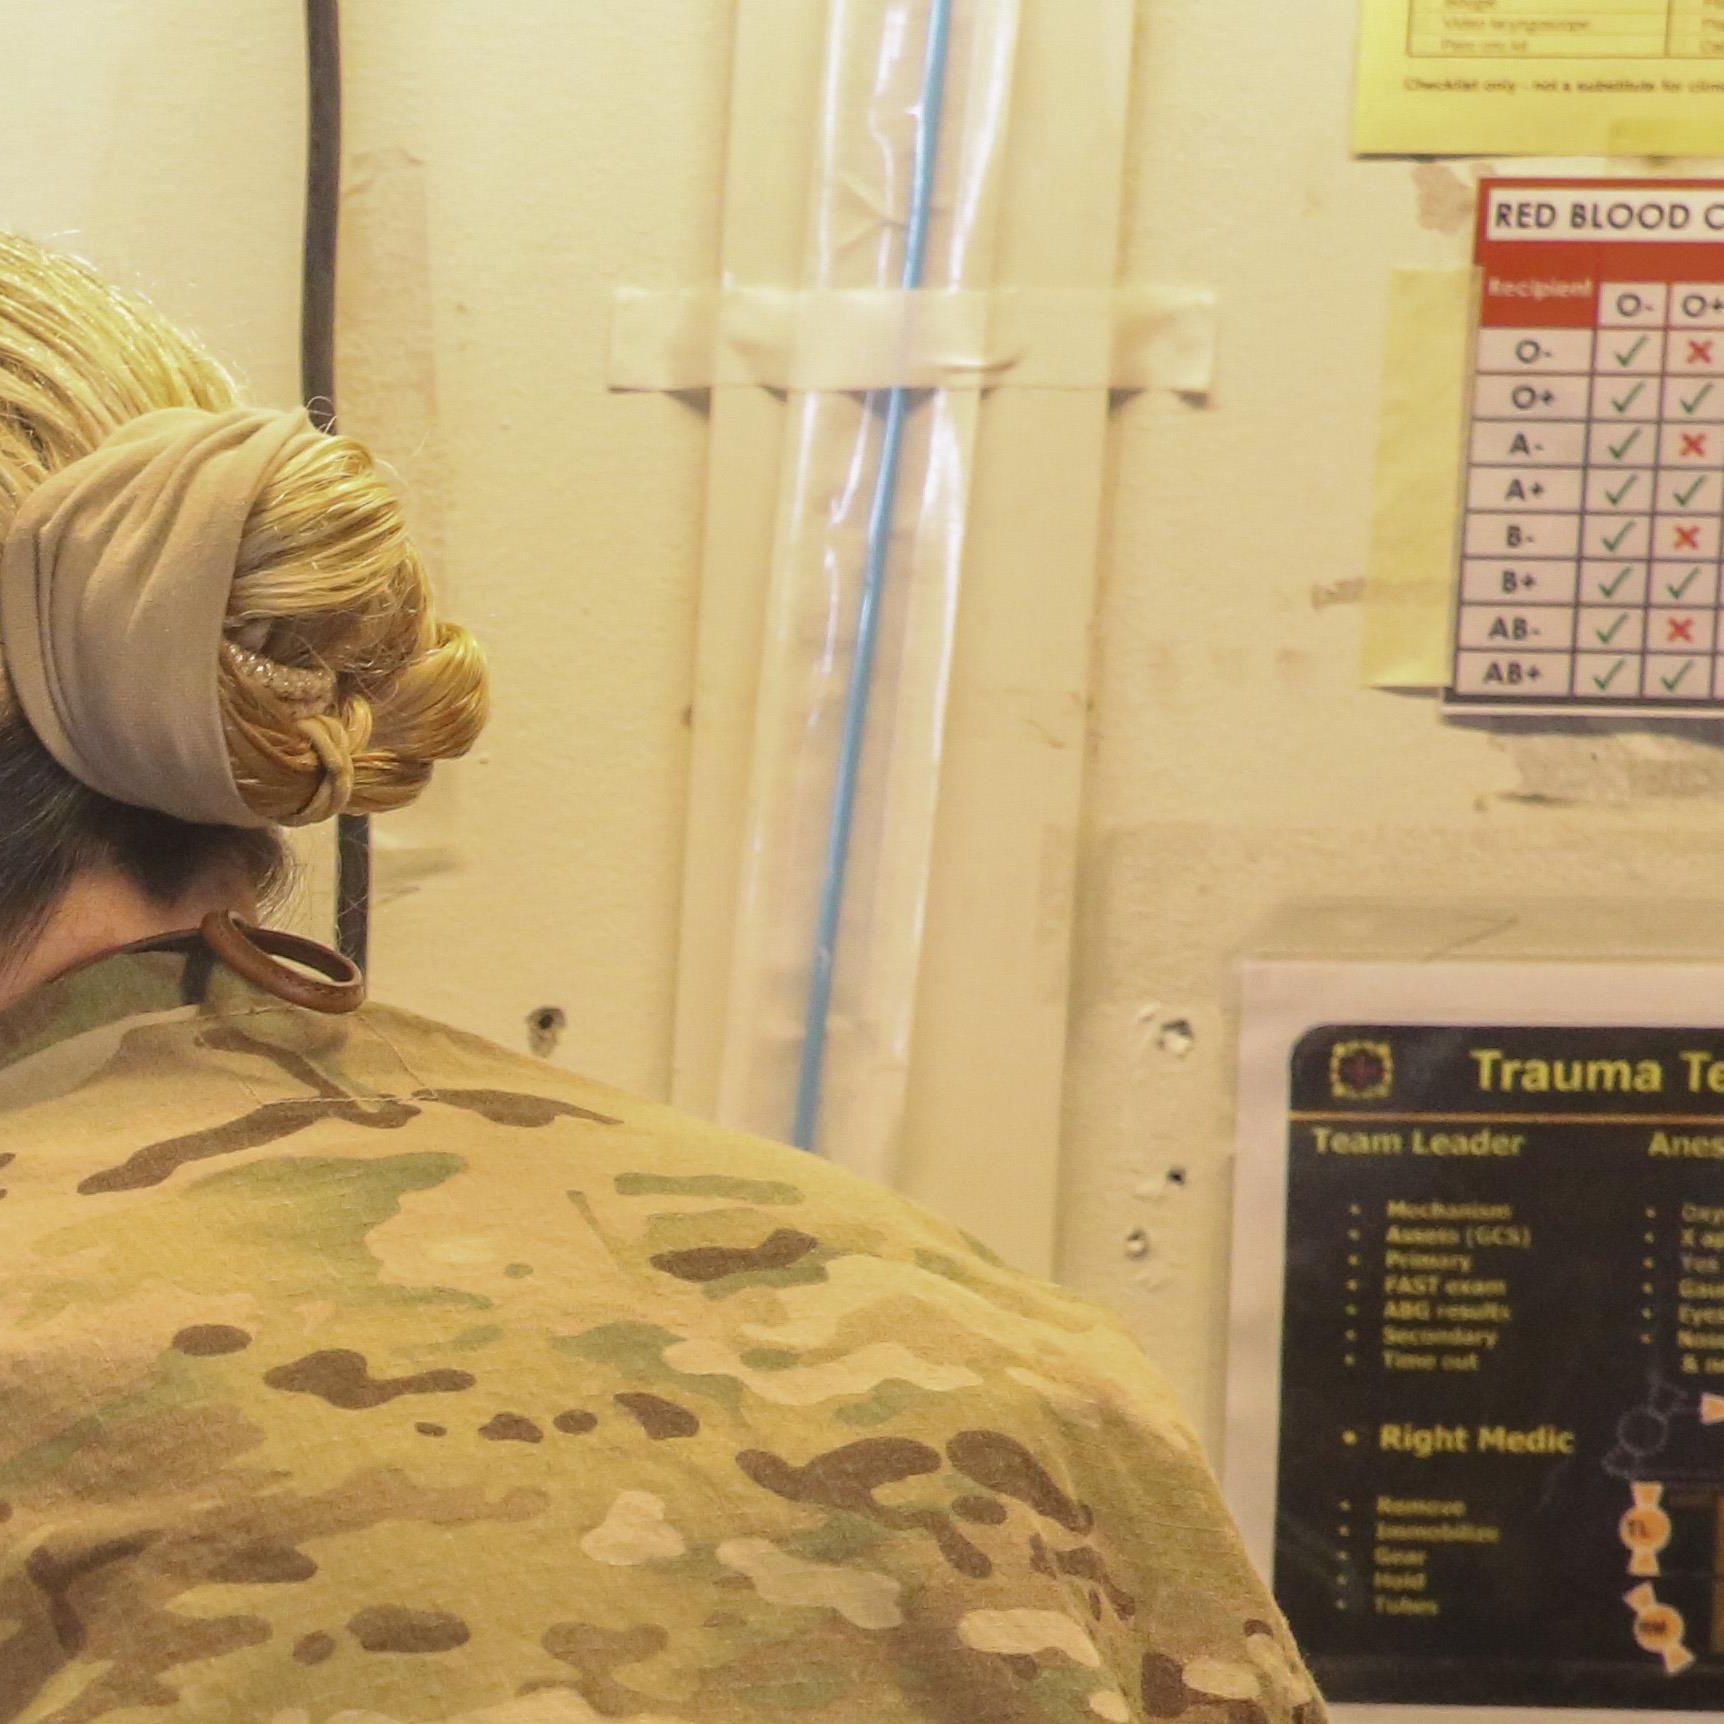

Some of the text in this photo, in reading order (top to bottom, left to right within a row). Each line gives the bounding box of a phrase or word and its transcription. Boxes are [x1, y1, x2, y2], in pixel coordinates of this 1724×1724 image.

[1495, 203, 1556, 229] RED
[1570, 204, 1690, 231] BLOOD
[1489, 277, 1594, 300] Recipient
[1469, 1048, 1663, 1093] Trauma
[1313, 1126, 1404, 1156] Team
[1412, 1128, 1525, 1157] Leader
[1379, 1423, 1576, 1458] Right Medic
